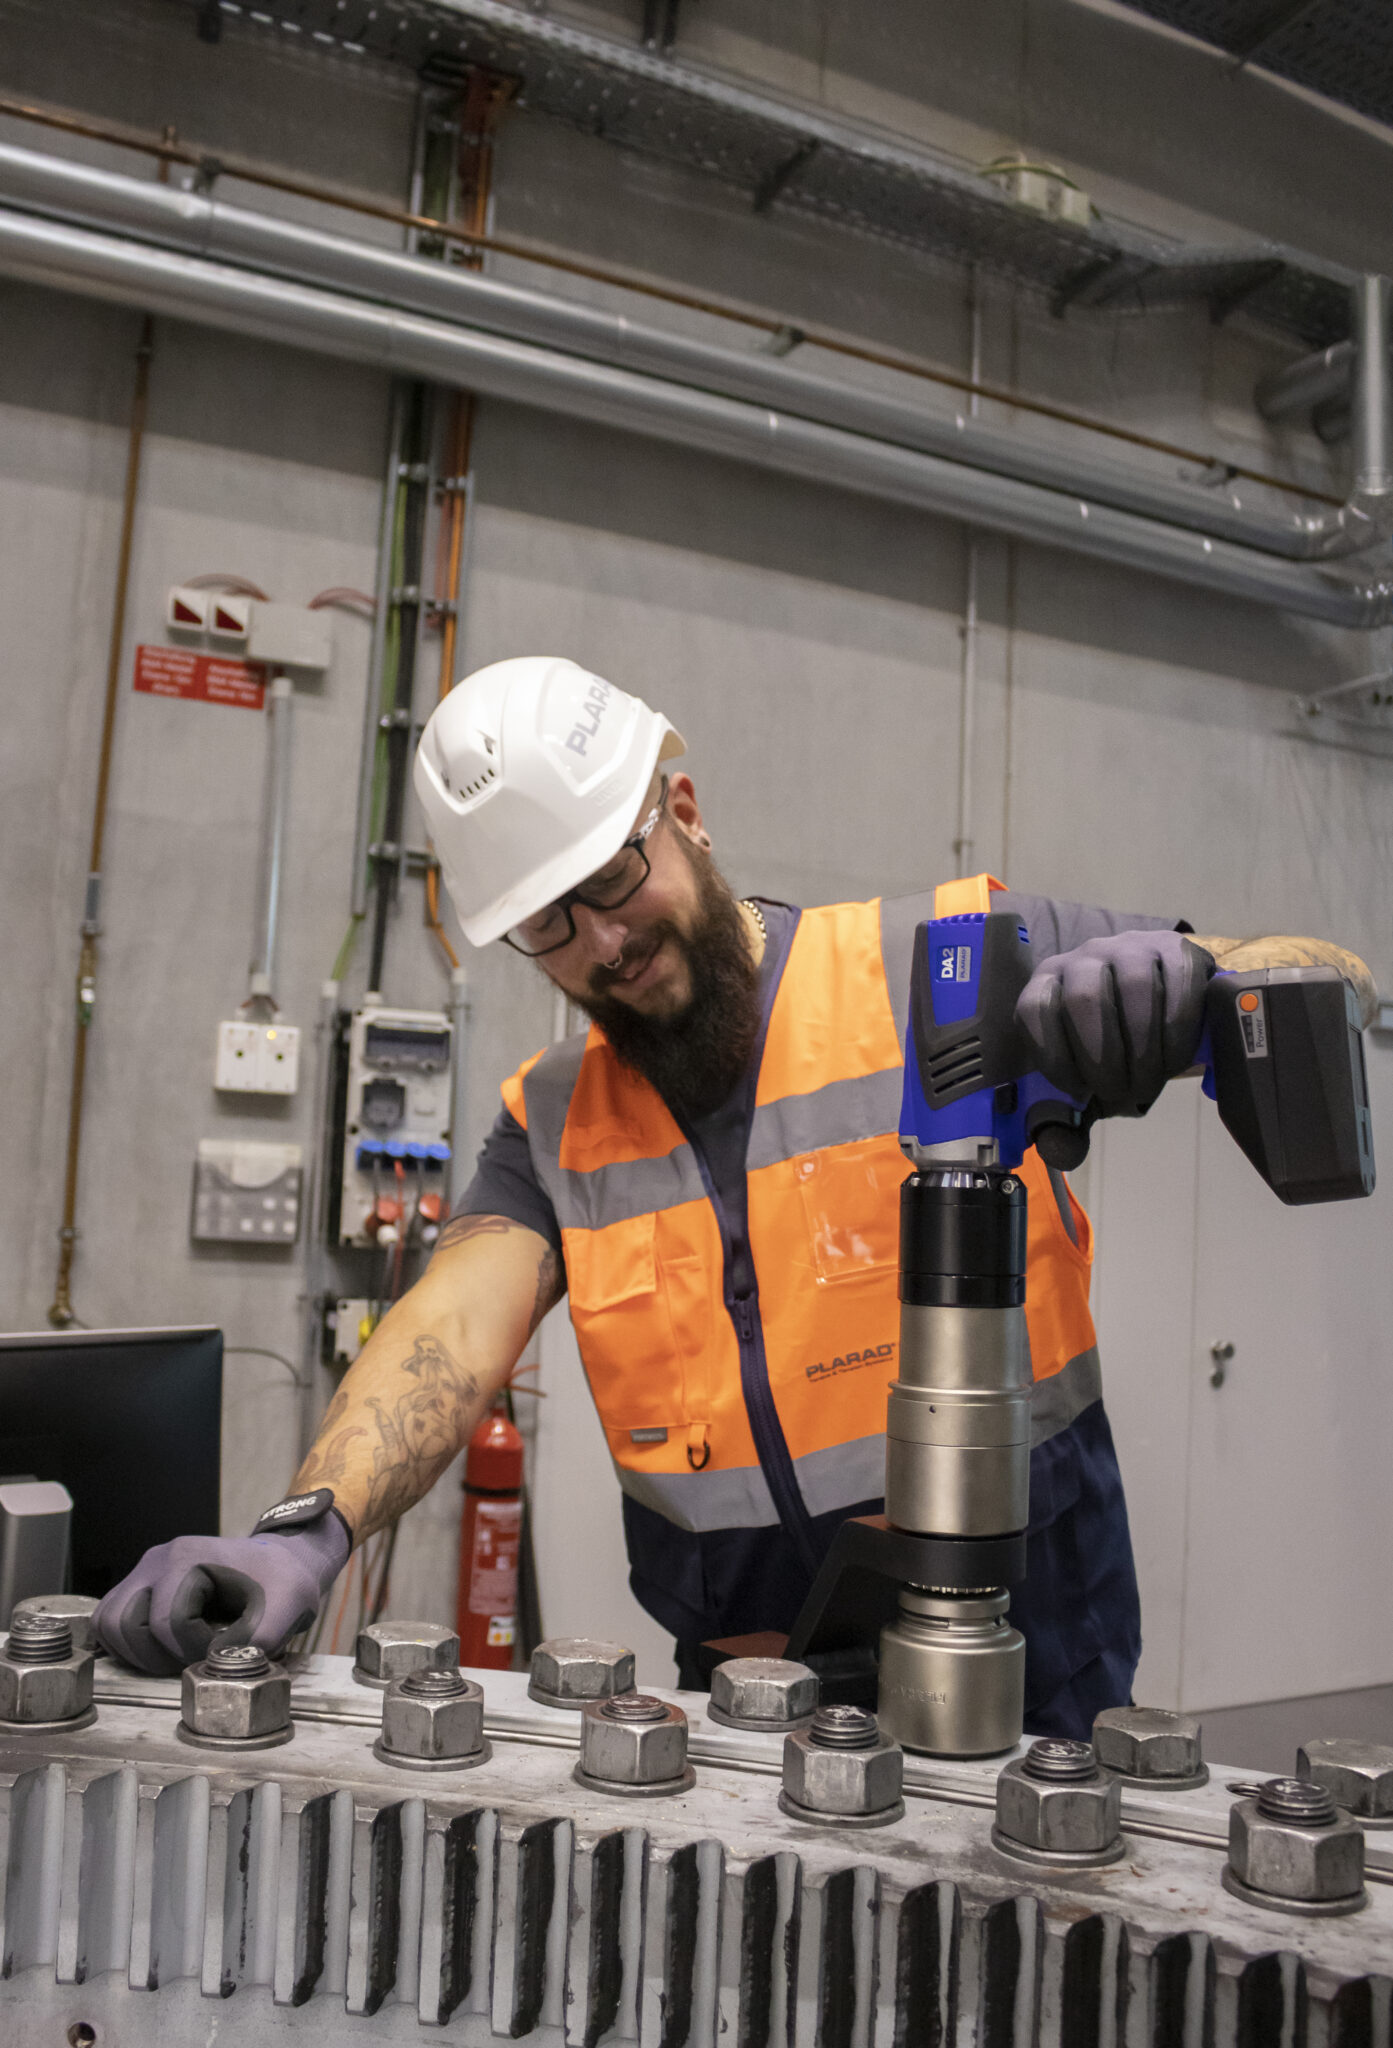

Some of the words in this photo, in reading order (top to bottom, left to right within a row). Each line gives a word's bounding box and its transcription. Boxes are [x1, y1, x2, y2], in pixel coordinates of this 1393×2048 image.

[941, 947, 954, 978] DA2
[1256, 1018, 1265, 1048] Power
[806, 1344, 892, 1378] PLARAD
